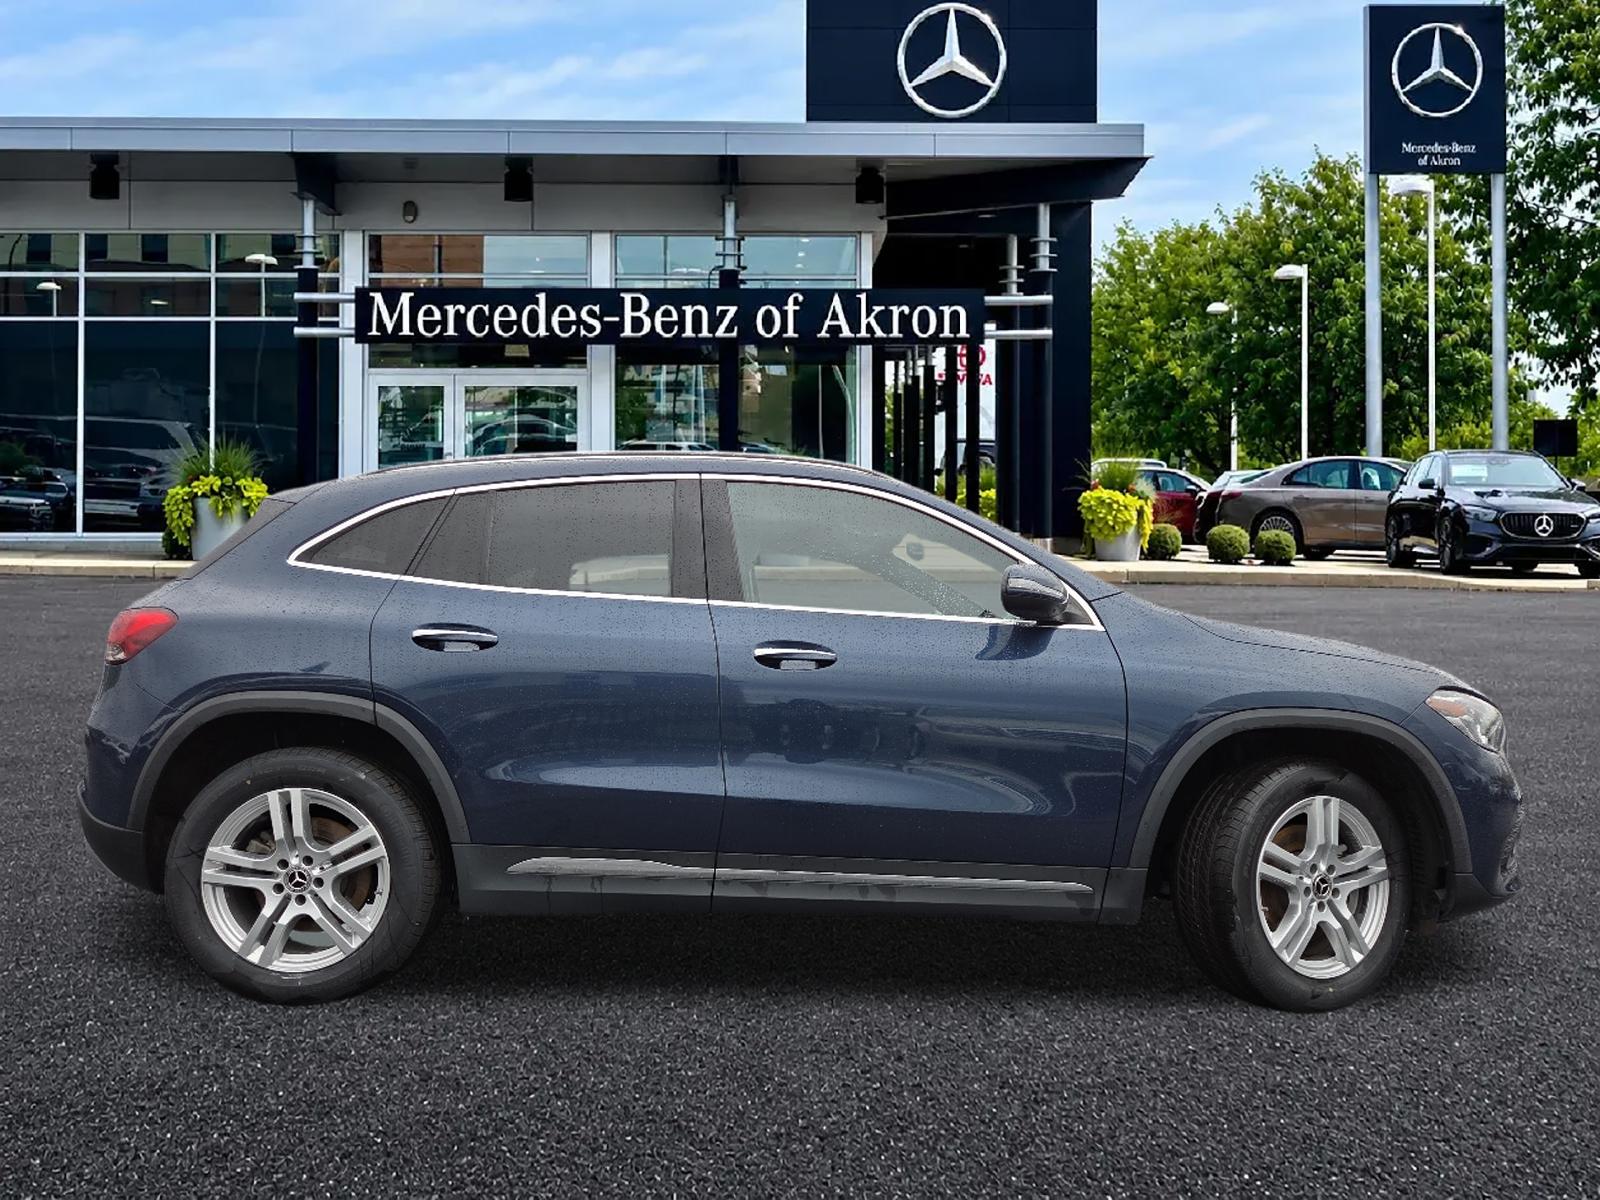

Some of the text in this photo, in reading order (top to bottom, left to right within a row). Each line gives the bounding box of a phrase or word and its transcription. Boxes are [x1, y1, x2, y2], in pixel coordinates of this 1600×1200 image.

[1401, 141, 1477, 154] Mercedes-Benz
[1417, 155, 1461, 166] of Akron
[367, 291, 970, 339] Mercedes-Benz of Akron
